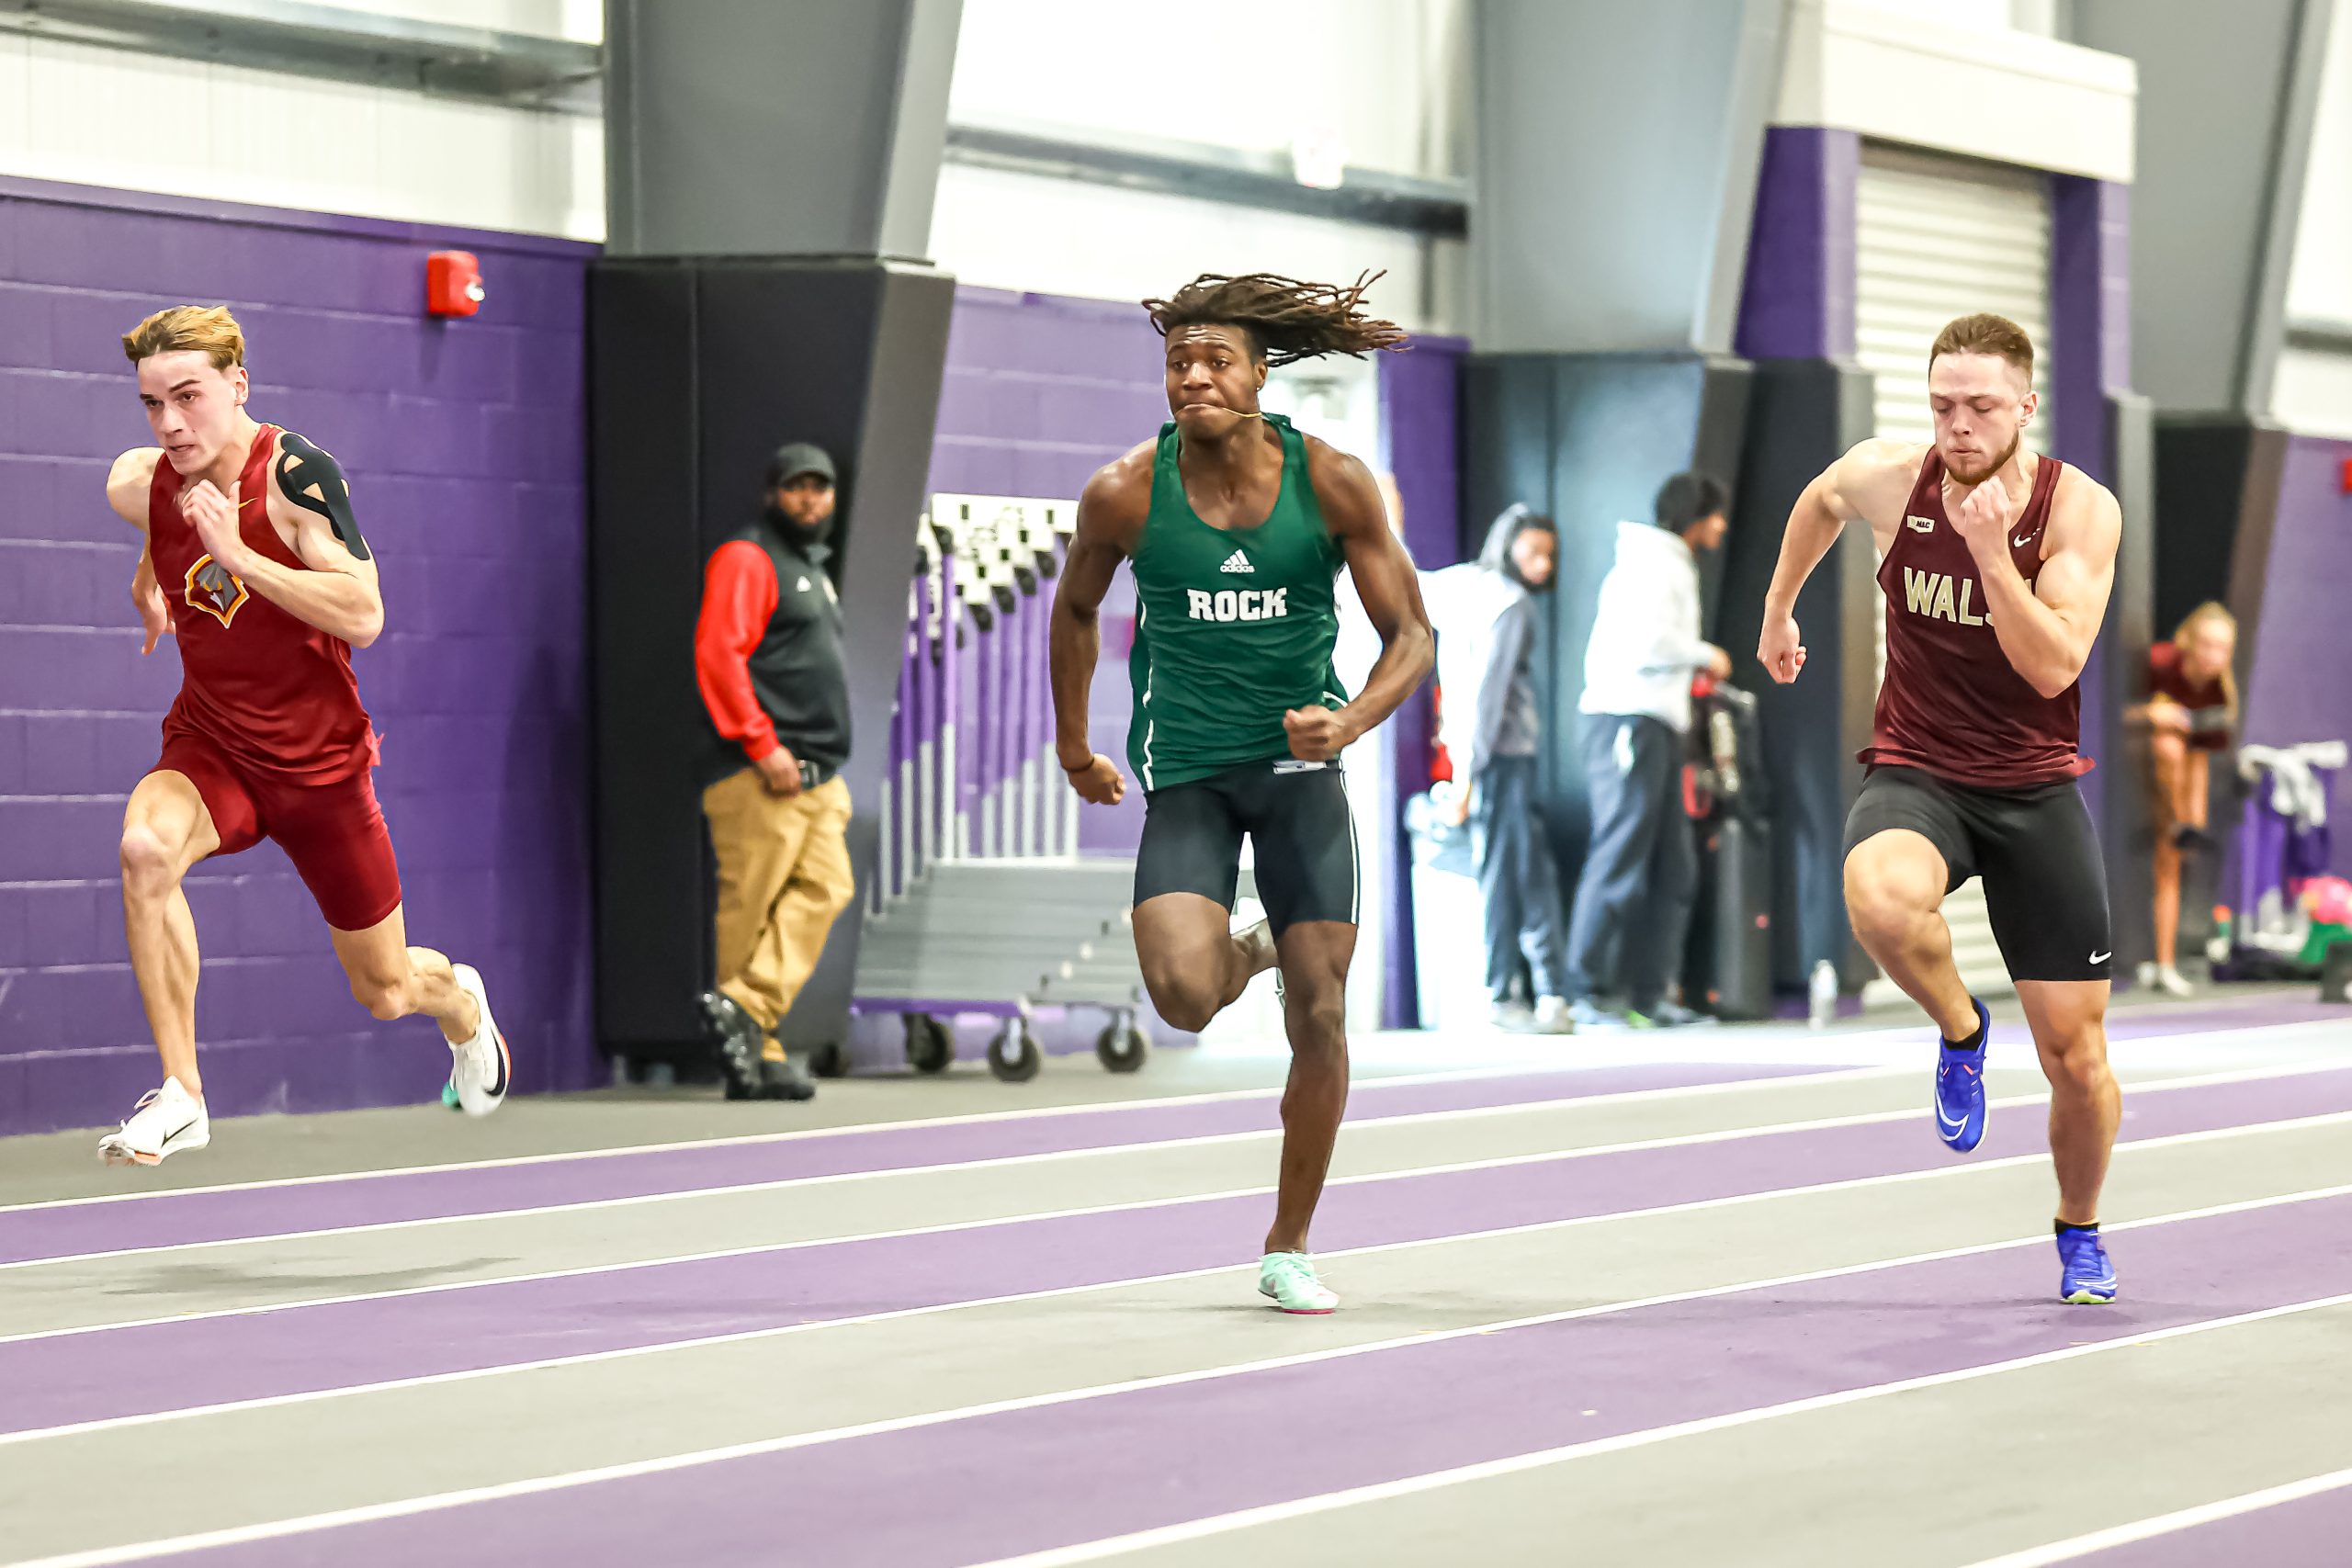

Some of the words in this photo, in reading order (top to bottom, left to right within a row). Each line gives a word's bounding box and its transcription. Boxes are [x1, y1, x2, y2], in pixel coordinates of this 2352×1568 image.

[1219, 563, 1255, 573] adidas
[1186, 586, 1288, 623] ROCK
[1904, 566, 2032, 626] WAL
